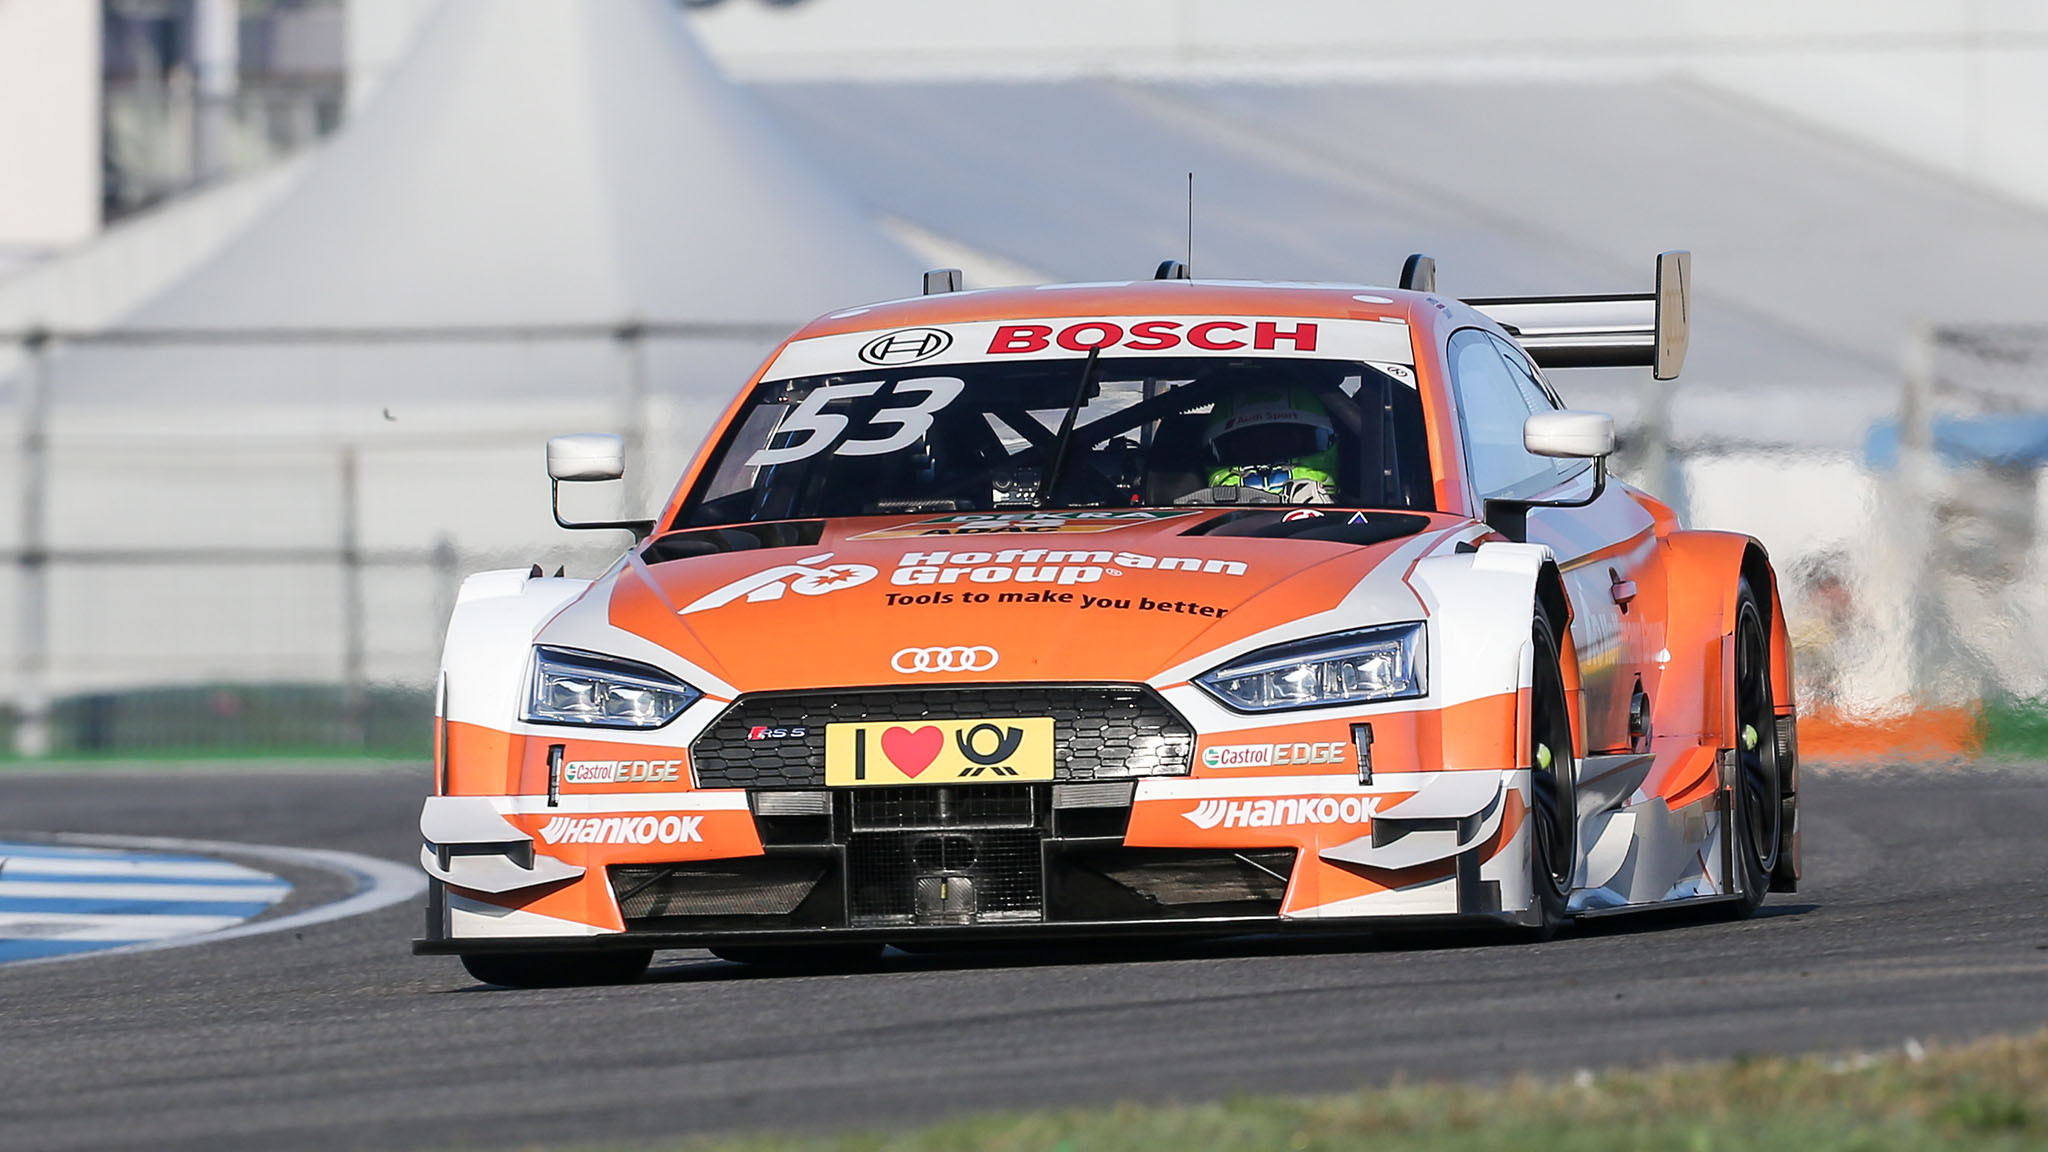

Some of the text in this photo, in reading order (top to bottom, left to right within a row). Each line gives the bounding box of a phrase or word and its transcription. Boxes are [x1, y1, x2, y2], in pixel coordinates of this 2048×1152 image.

[986, 321, 1318, 355] BOSCH
[744, 376, 965, 466] 53
[919, 526, 1059, 536] ADAC
[897, 548, 1249, 577] Hoffmann
[885, 589, 1229, 619] Tools to make you better
[854, 728, 866, 781] I
[1220, 742, 1348, 766] Castrol EDGE
[576, 760, 682, 783] Castrol EDGE
